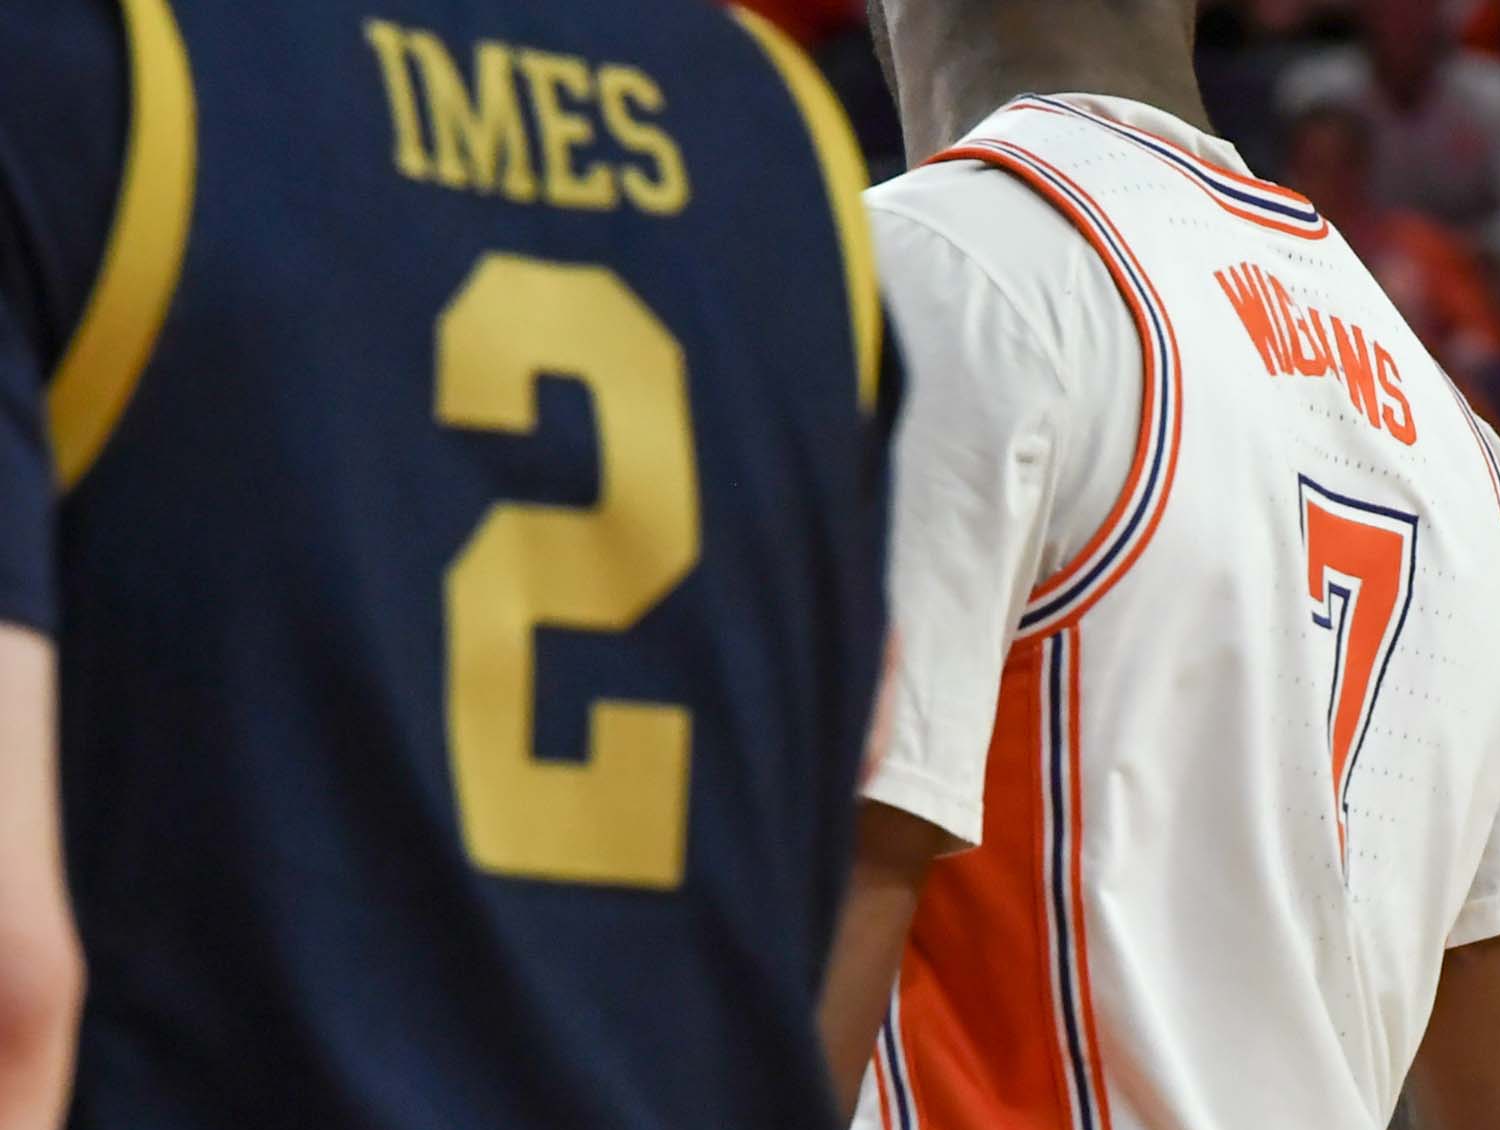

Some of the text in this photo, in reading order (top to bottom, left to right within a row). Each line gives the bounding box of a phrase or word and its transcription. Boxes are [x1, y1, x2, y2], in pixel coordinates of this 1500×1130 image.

[363, 17, 691, 217] IMES
[433, 252, 703, 892] 2
[1298, 472, 1419, 886] 7
